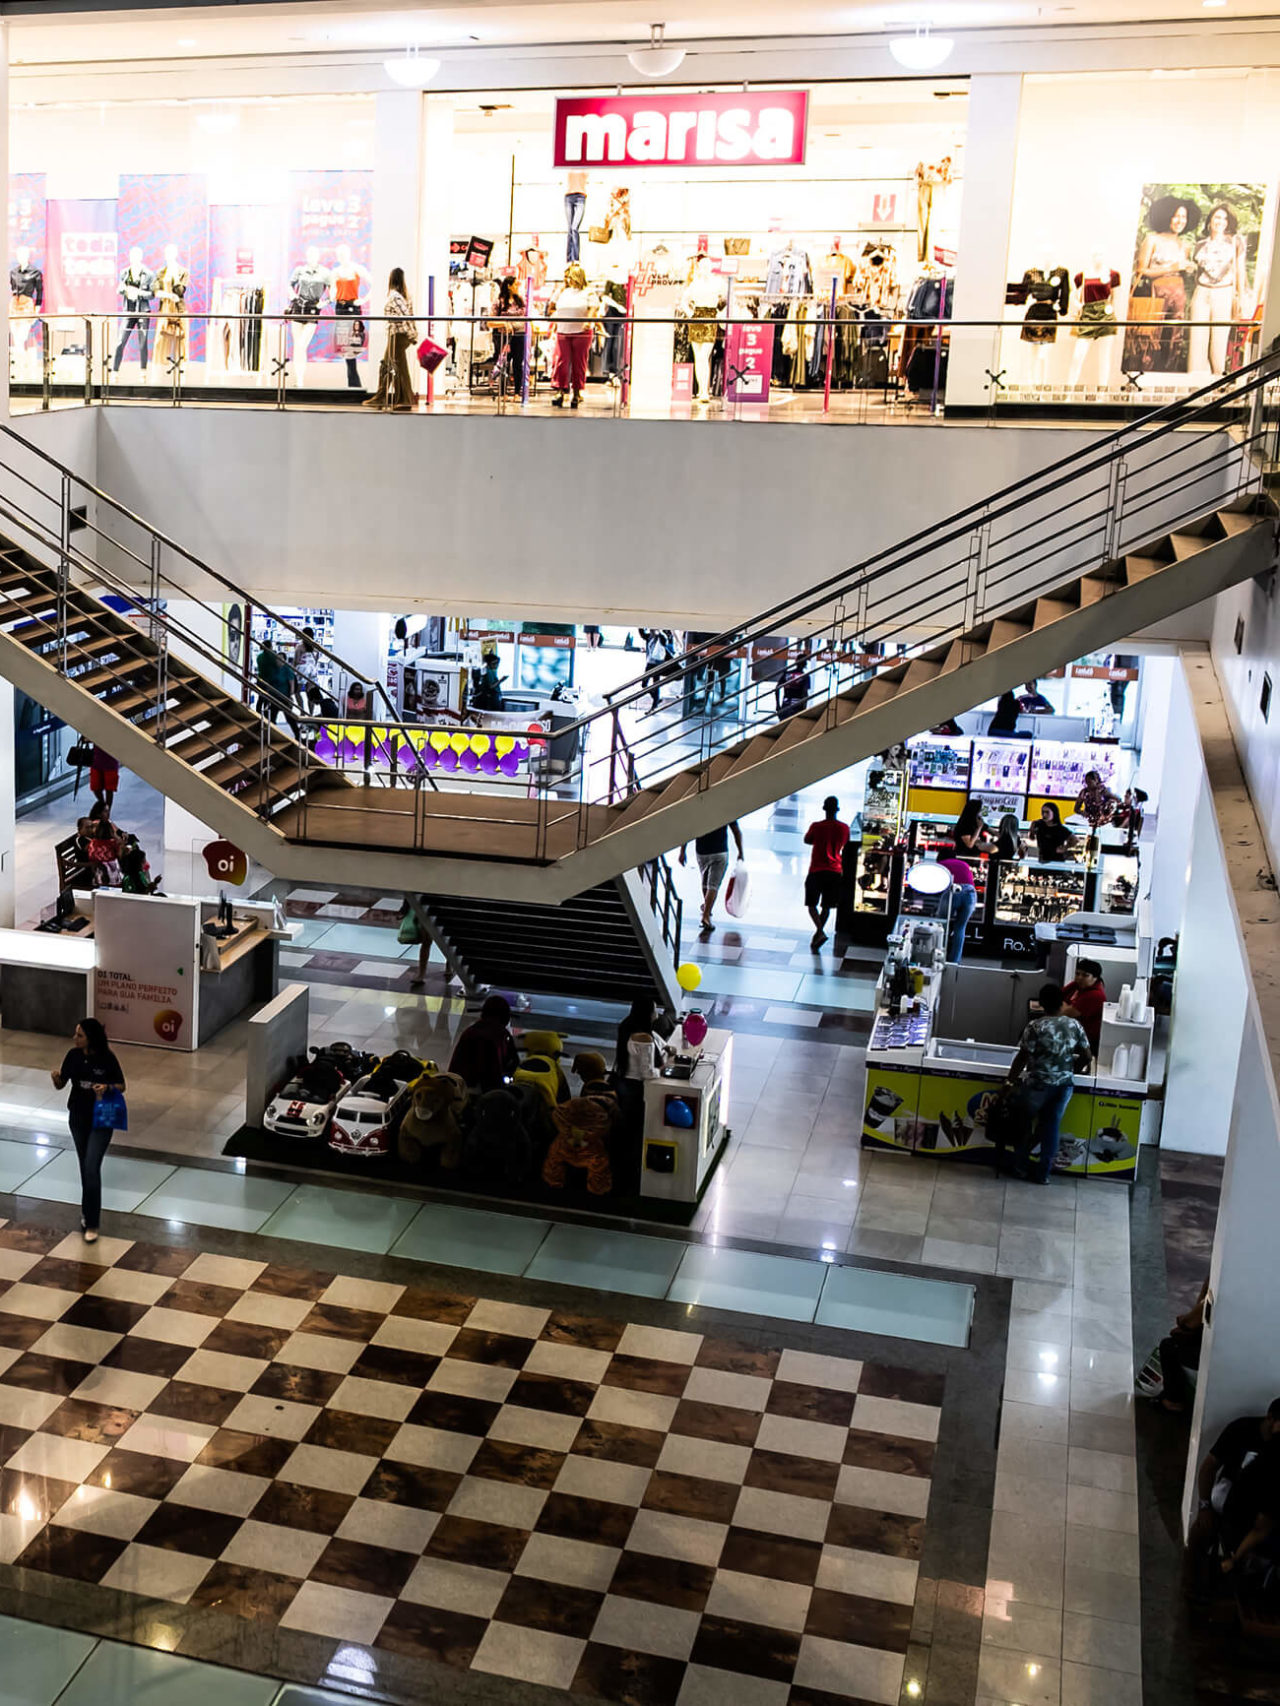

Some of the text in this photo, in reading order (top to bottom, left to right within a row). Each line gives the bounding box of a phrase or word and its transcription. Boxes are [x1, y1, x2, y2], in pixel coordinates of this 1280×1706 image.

[563, 107, 795, 162] marisa
[746, 333, 757, 346] 3
[745, 357, 756, 369] 2
[218, 854, 235, 872] oi
[162, 1020, 175, 1033] oi
